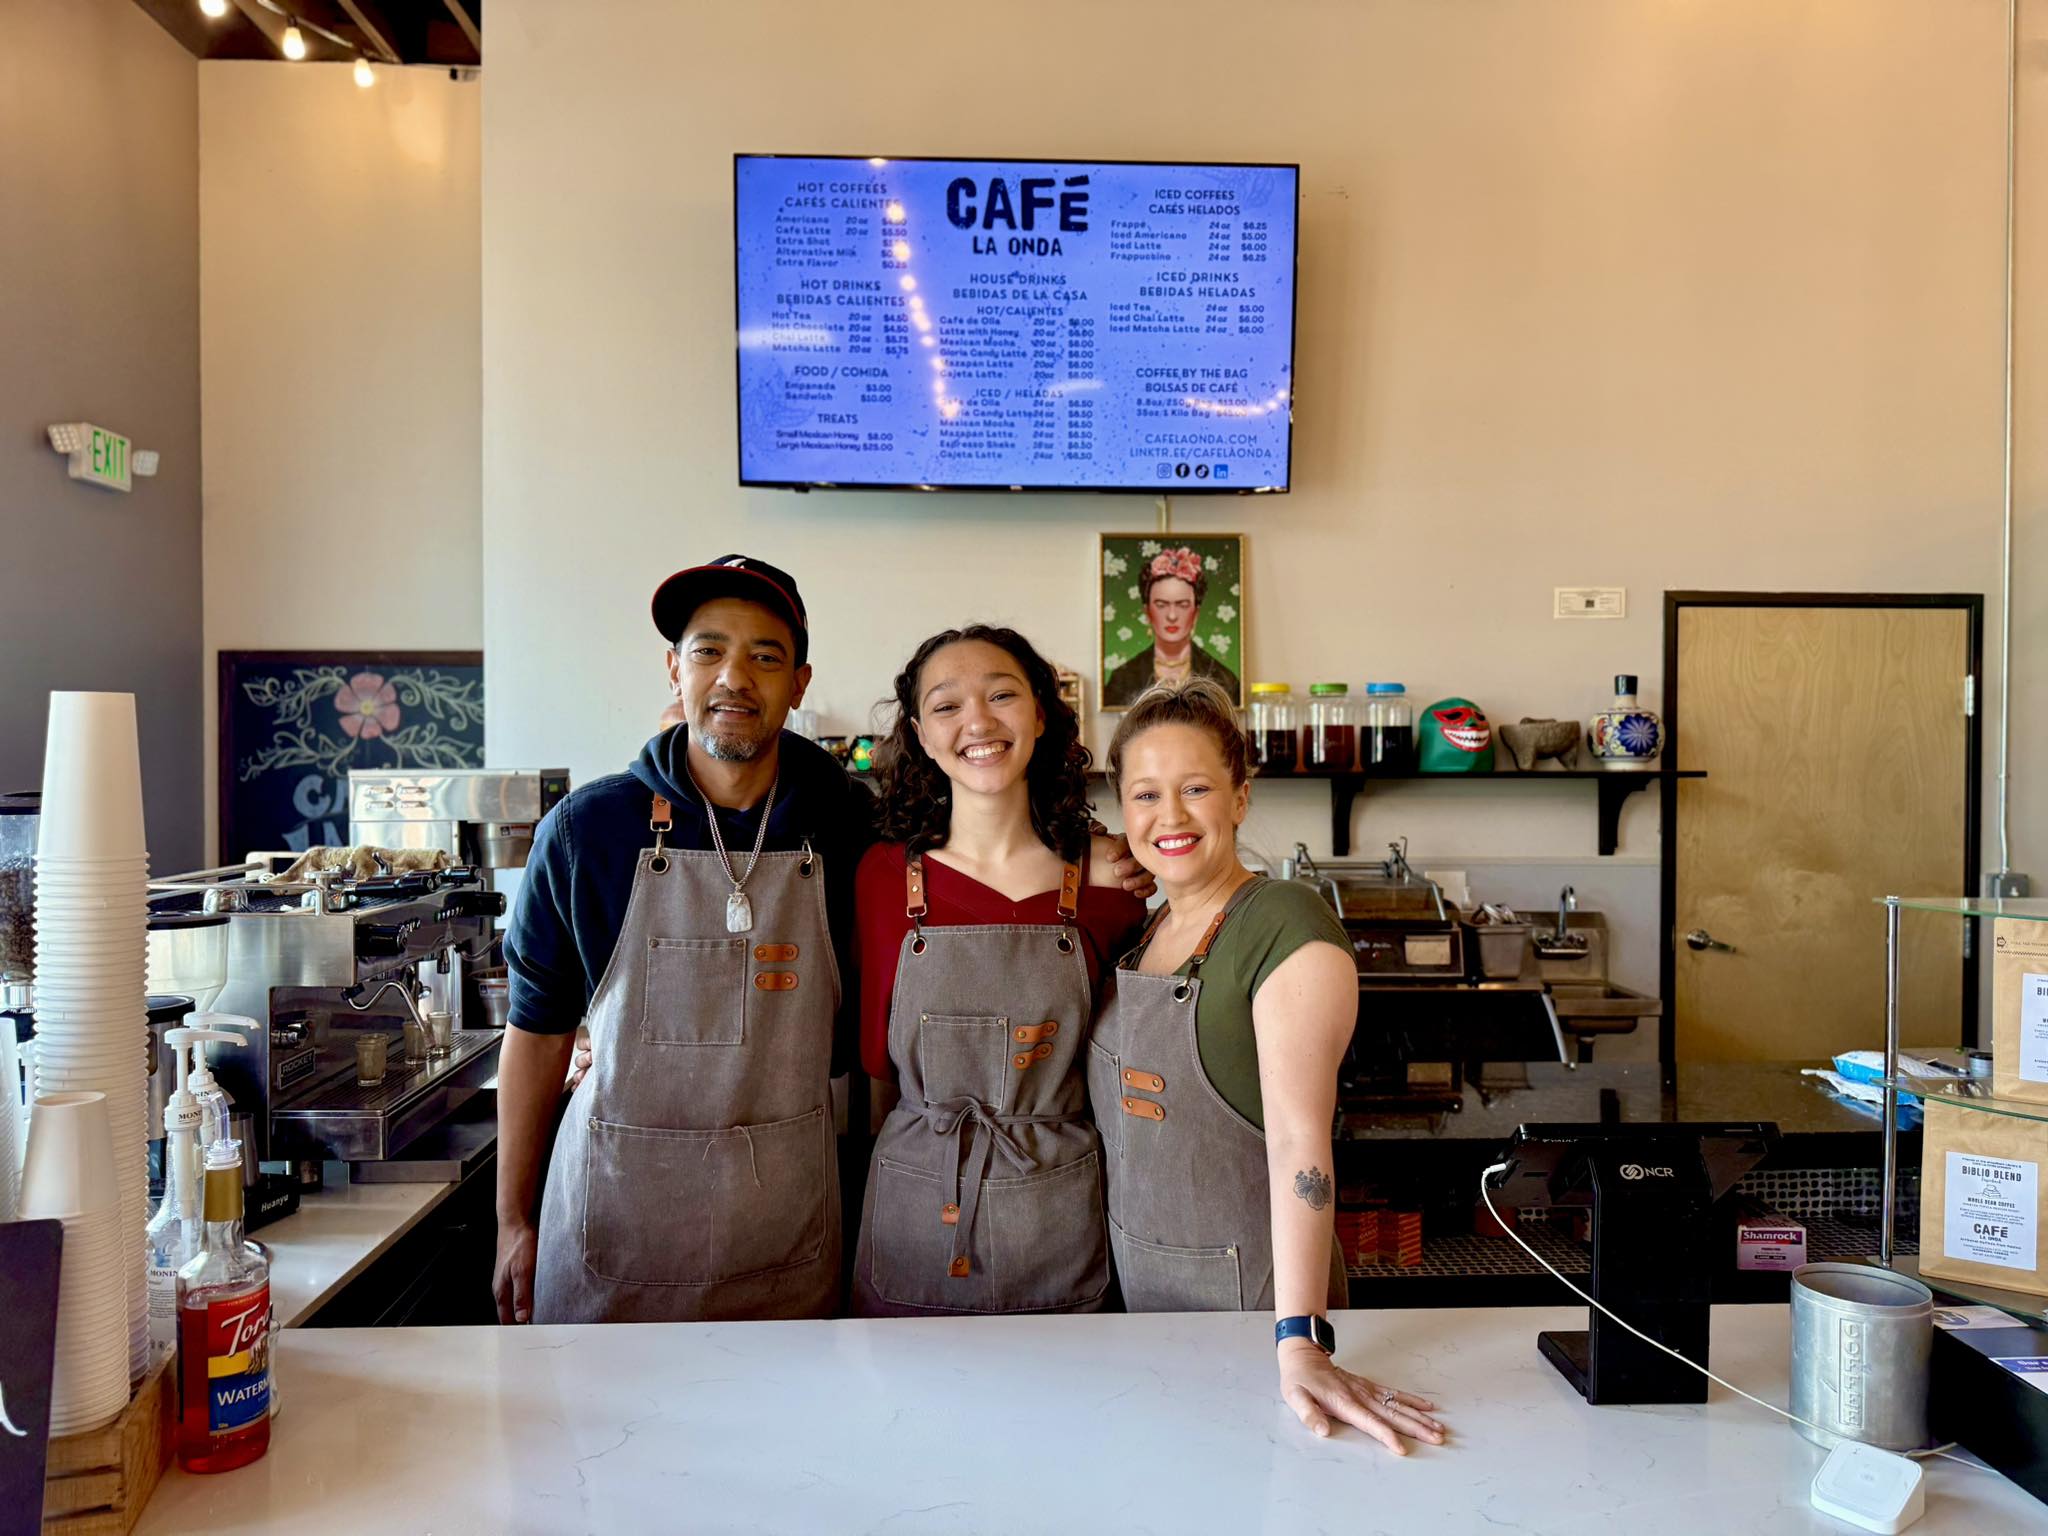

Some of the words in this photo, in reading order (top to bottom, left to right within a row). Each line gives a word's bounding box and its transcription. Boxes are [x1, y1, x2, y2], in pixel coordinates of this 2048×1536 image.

[798, 183, 823, 193] HOT
[830, 183, 887, 194] COFFEES
[1155, 190, 1181, 199] ICED
[1185, 190, 1234, 200] COFFEES
[947, 175, 1090, 232] CAFÉ
[1149, 202, 1184, 214] CAFÉS
[1188, 205, 1240, 215] HELADOS
[776, 216, 829, 224] Americano
[803, 227, 830, 235] Latte
[1111, 231, 1131, 239] Iced
[807, 238, 830, 246] Shot
[973, 236, 997, 255] LA
[1009, 238, 1062, 256] ONDA
[776, 248, 833, 256] Alternative
[837, 249, 856, 257] Milk
[808, 259, 838, 267] Flavor
[970, 274, 1013, 284] HOUSE
[1019, 275, 1066, 285] DRINKS
[1157, 272, 1186, 282] ICED
[1192, 273, 1239, 283] DRINKS
[801, 280, 828, 290] HOT
[833, 281, 881, 291] DRINKS
[953, 289, 1007, 299] BEBIDAS
[1012, 290, 1029, 299] DE
[1033, 290, 1049, 300] LA
[1053, 291, 1087, 300] CASA
[1140, 287, 1193, 296] BEBIDAS
[1198, 288, 1255, 297] HELADAS
[777, 295, 831, 305] BEBIDAS
[837, 296, 905, 306] CALIENTES
[772, 312, 790, 320] Hot
[794, 312, 811, 320] Tea
[977, 306, 1063, 317] HOT/CALIENTES
[981, 317, 1001, 325] Olla
[1110, 314, 1130, 322] Iced
[1133, 314, 1155, 322] Chai
[793, 323, 844, 331] Chocolate
[1133, 325, 1170, 333] Matcha
[1173, 325, 1200, 333] Latte
[940, 327, 965, 336] Latte
[968, 328, 989, 336] with
[991, 328, 1019, 338] Honey
[940, 338, 981, 346] Mexican
[984, 338, 1015, 347] Mocha
[813, 345, 840, 353] Latte
[940, 349, 968, 357] Gloria
[971, 350, 999, 359] Candy
[1002, 350, 1027, 358] Latte
[987, 360, 1013, 368] Latte
[795, 367, 829, 376] FOOD
[831, 367, 838, 379] /
[842, 367, 888, 378] COMIDA
[1136, 368, 1178, 378] COFFEE
[1182, 368, 1197, 378] BY
[1201, 369, 1221, 378] THE
[1224, 369, 1248, 378] BAG
[785, 382, 836, 391] Empanada
[866, 384, 891, 392] $3.00
[1146, 383, 1188, 392] BOLSAS
[1192, 383, 1205, 392] DE
[1209, 382, 1238, 392] CAFÉ
[785, 393, 832, 401] Sandwich
[861, 394, 892, 402] $10.00
[976, 389, 1001, 398] ICED
[1016, 389, 1063, 398] HELADAS
[1172, 409, 1189, 417] Kilo
[818, 414, 858, 424] TREATS
[940, 420, 980, 428] Mexican
[983, 420, 1015, 428] Mocha
[1145, 433, 1257, 444] CAFELAONDA.COM
[987, 441, 1015, 449] Shake
[93, 430, 126, 480] EXIT
[940, 451, 973, 460] Cajeta
[1130, 448, 1272, 460] LINKTR.EE/CAFELAONDA
[282, 1052, 313, 1074] ROCKET
[1644, 1166, 1675, 1178] NCR
[1962, 1165, 1990, 1178] BIBLIO
[1993, 1170, 2022, 1182] BLEND
[261, 1193, 289, 1213] Huanyu
[1973, 1223, 2008, 1238] CAFÉ
[1743, 1231, 1797, 1241] Shamrock
